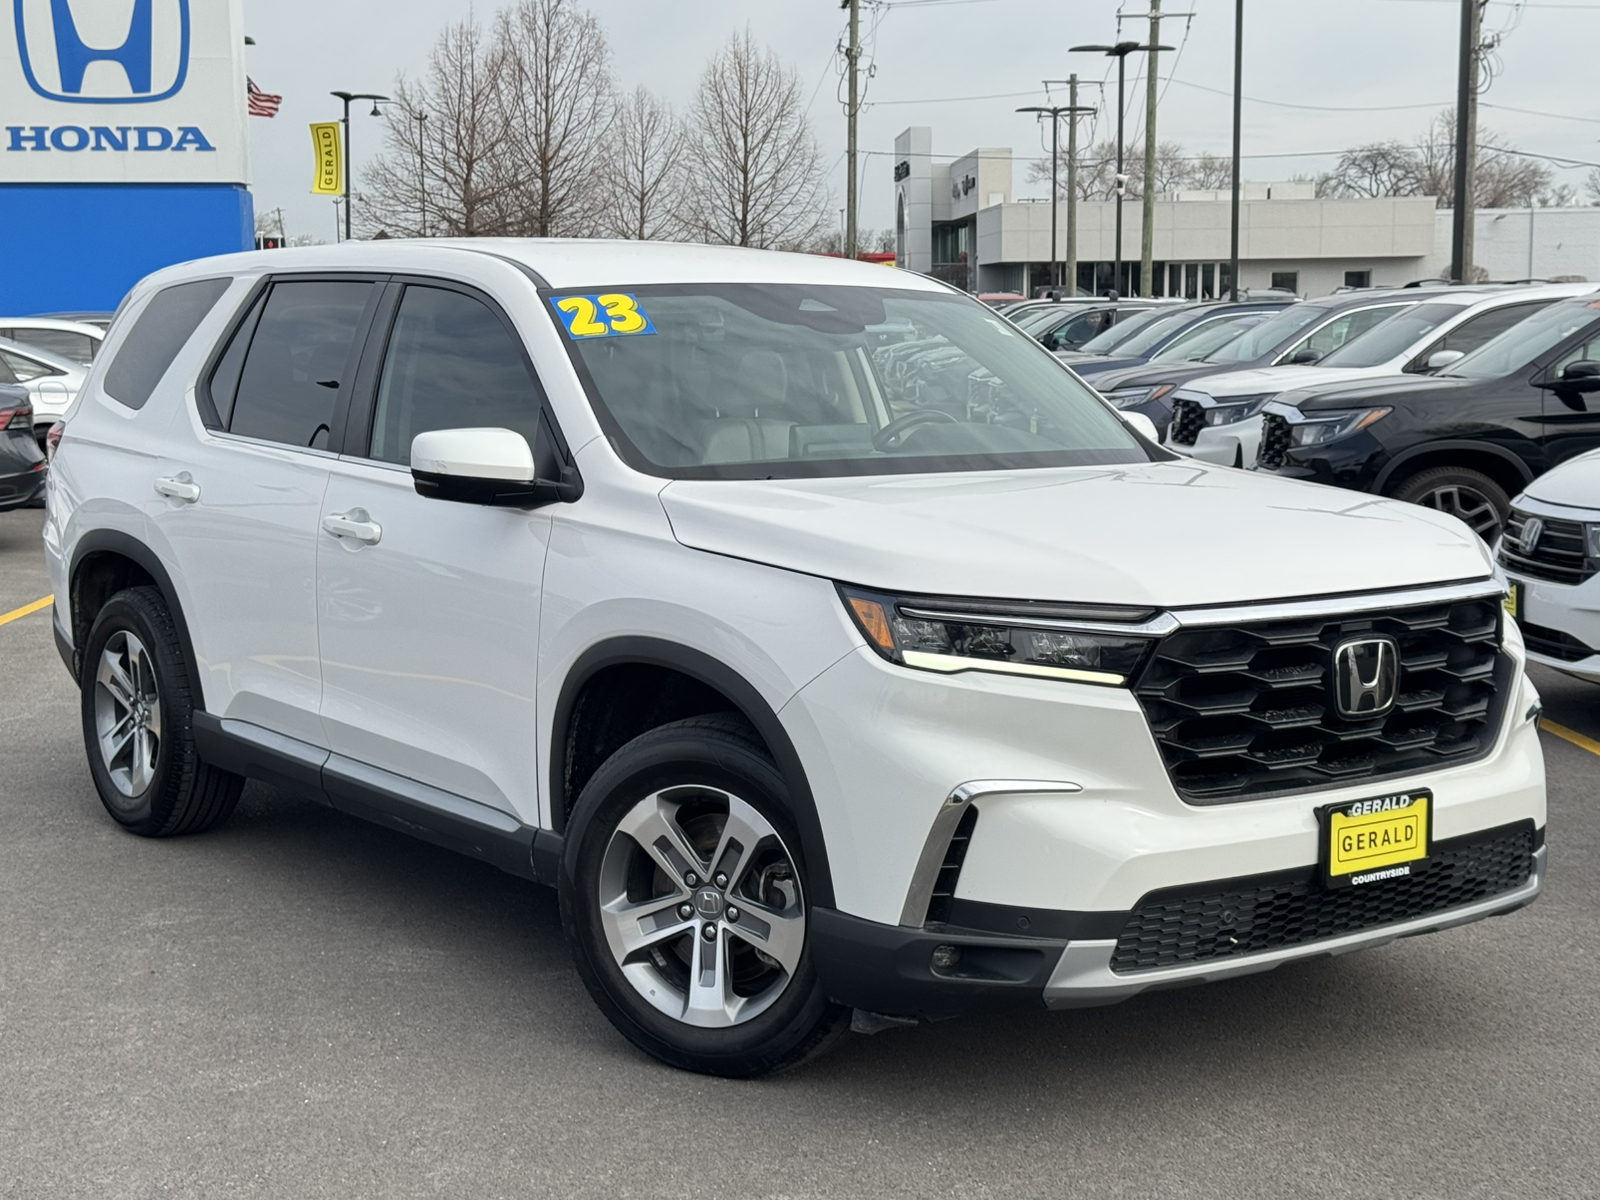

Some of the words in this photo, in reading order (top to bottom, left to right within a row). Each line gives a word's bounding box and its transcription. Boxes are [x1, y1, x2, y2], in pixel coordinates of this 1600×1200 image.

[5, 125, 216, 152] HONDA
[322, 131, 334, 186] GERALD
[557, 293, 648, 335] 23
[1352, 795, 1409, 816] GERALD
[1342, 825, 1413, 852] GERALD
[1352, 866, 1410, 885] COUNTRYSIDE
